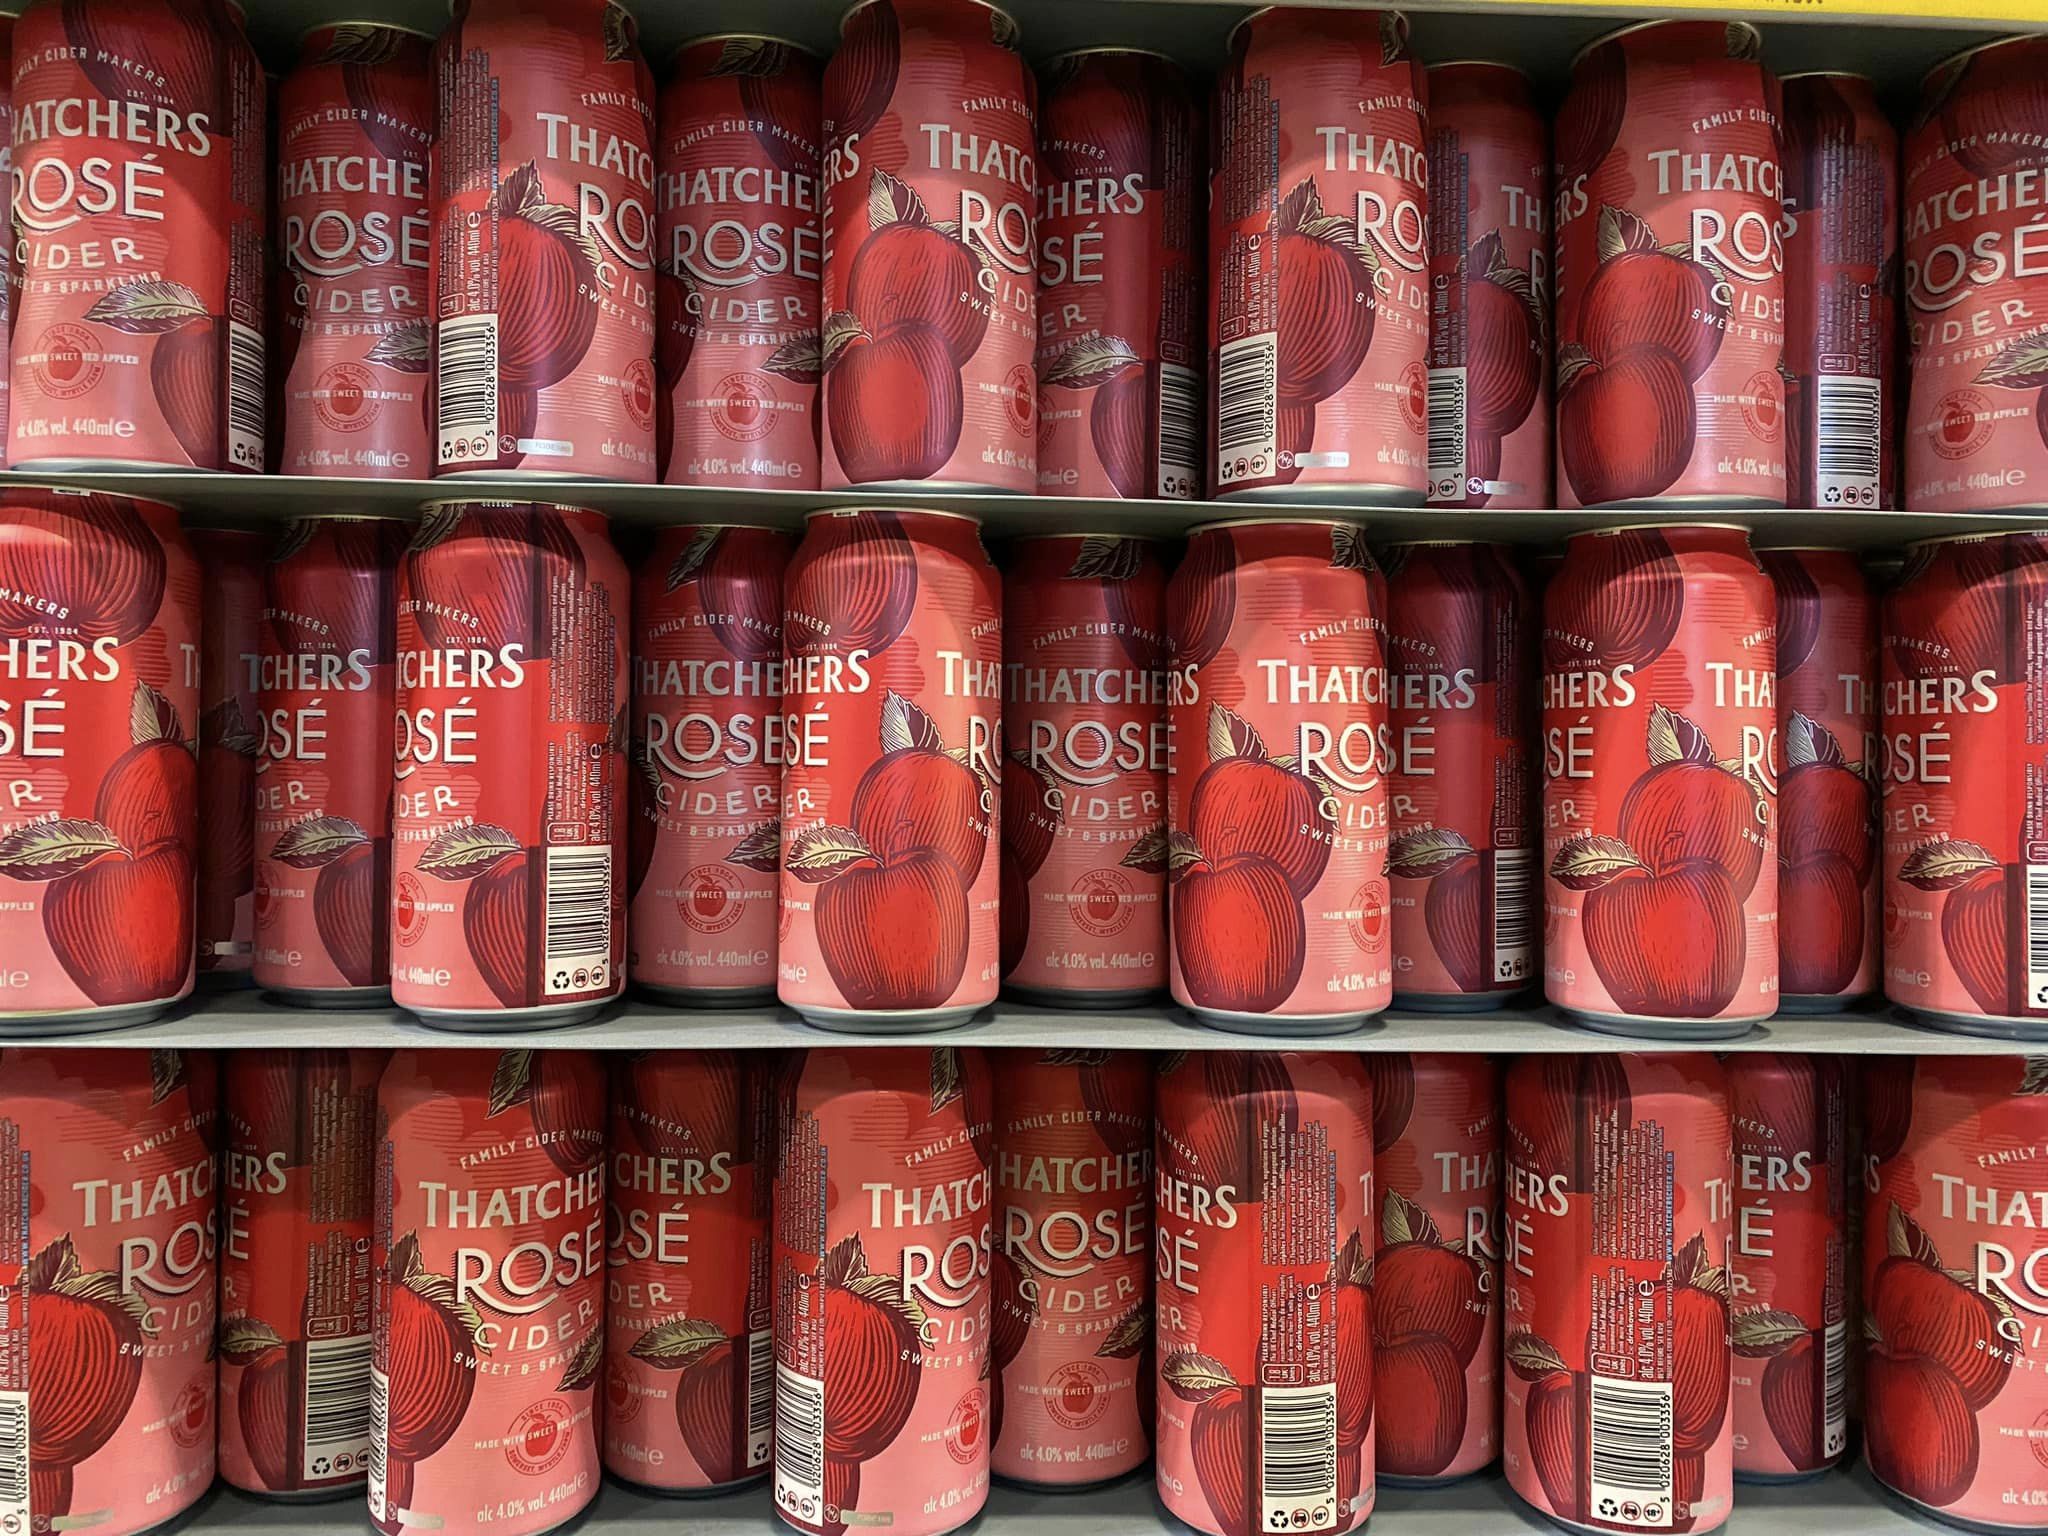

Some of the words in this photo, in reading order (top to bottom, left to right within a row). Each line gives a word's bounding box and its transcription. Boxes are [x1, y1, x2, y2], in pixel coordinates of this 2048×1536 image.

[45, 47, 87, 62] CIDER
[97, 50, 167, 88] MAKERS
[581, 91, 626, 106] FAMILY
[962, 96, 1007, 113] FAMILY
[1358, 96, 1402, 115] FAMILY
[327, 109, 368, 121] CIDER
[1692, 107, 1743, 134] FAMILY
[674, 125, 715, 155] FAMILY
[723, 120, 764, 132] CIDER
[1054, 139, 1106, 161] MAKERS
[11, 153, 164, 231] ROSÉ
[16, 237, 144, 270] CIDER
[287, 208, 430, 277] ROSÉ
[673, 220, 820, 287] ROSÉ
[294, 283, 417, 313] CIDER
[578, 283, 625, 319] SWEET
[685, 292, 808, 323] CIDER
[959, 291, 1006, 327] SWEET
[1356, 291, 1401, 323] SWEET
[672, 320, 713, 343] SWEET
[1691, 308, 1742, 338] SWEET
[1911, 299, 2033, 345] CIDER
[485, 326, 496, 370] 003356
[1264, 344, 1274, 390] 003356
[485, 376, 496, 421] 020628
[1454, 378, 1464, 418] 003356
[1264, 393, 1274, 438] 020628
[1454, 423, 1464, 464] 020628
[1718, 457, 1733, 474] alc
[1735, 457, 1757, 475] 4.0%
[0, 588, 70, 620] MAKERS
[426, 602, 479, 629] MAKERS
[280, 609, 329, 636] MAKERS
[694, 613, 734, 626] CIDER
[793, 610, 832, 637] MAKERS
[1300, 619, 1348, 646] FAMILY
[1353, 617, 1379, 631] CIDER
[1033, 626, 1077, 650] FAMILY
[1086, 623, 1125, 635] CIDER
[1554, 630, 1594, 652] MAKERS
[1901, 635, 1950, 659] MAKERS
[656, 782, 779, 816] CIDER
[1043, 788, 1160, 821] CIDER
[589, 806, 600, 827] 4.0%
[644, 807, 682, 833] SWEET
[1028, 812, 1073, 838] SWEET
[1300, 823, 1352, 849] SWEET
[696, 890, 723, 899] SWEET
[1089, 894, 1115, 903] SWEET
[1323, 911, 1343, 920] MADE
[1345, 911, 1363, 920] WITH
[1062, 952, 1087, 968] 4.0%
[1328, 974, 1341, 992] alc
[1343, 972, 1364, 992] 4.0%
[640, 1111, 692, 1140] MAKERS
[1008, 1114, 1053, 1134] FAMILY
[1061, 1111, 1101, 1124] CIDER
[123, 1125, 177, 1161] FAMILY
[459, 1140, 516, 1170] FAMILY
[525, 1130, 566, 1149] CIDER
[905, 1135, 953, 1168] FAMILY
[1162, 1130, 1199, 1166] MAKERS
[1978, 1146, 2036, 1168] FAMILY
[615, 1152, 732, 1195] CHERS
[1005, 1193, 1145, 1277] ROSÉ
[457, 1208, 601, 1314] ROSÉ
[609, 1280, 672, 1308] DER
[1018, 1275, 1136, 1313] CIDER
[473, 1299, 593, 1351] CIDER
[1003, 1300, 1049, 1331] SWEET
[119, 1342, 174, 1357] SWEET
[453, 1352, 512, 1376] SWEET
[901, 1349, 951, 1369] SWEET
[1307, 1346, 1320, 1368] 4.0%
[1638, 1342, 1654, 1364] 4.0%
[1976, 1339, 2034, 1371] SWEET
[1307, 1370, 1320, 1382] alc
[1638, 1366, 1654, 1378] alc
[1065, 1387, 1091, 1396] SWEET
[16, 1404, 26, 1449] 003356
[811, 1392, 823, 1437] 003356
[1325, 1395, 1335, 1439] 003356
[1660, 1394, 1670, 1439] 003356
[474, 1439, 499, 1450] MADE
[502, 1435, 525, 1447] WITH
[527, 1425, 554, 1441] SWEET
[921, 1432, 942, 1443] MADE
[2000, 1427, 2024, 1437] MADE
[811, 1442, 822, 1487] 020628
[1036, 1446, 1062, 1463] 4.0%
[1325, 1444, 1335, 1489] 020628
[1660, 1443, 1670, 1488] 020628
[16, 1455, 27, 1500] 020628
[477, 1504, 494, 1523] alc
[497, 1499, 525, 1519] 4.0%
[924, 1496, 937, 1515] alc
[939, 1487, 961, 1511] 4.0%
[2002, 1490, 2019, 1505] alc
